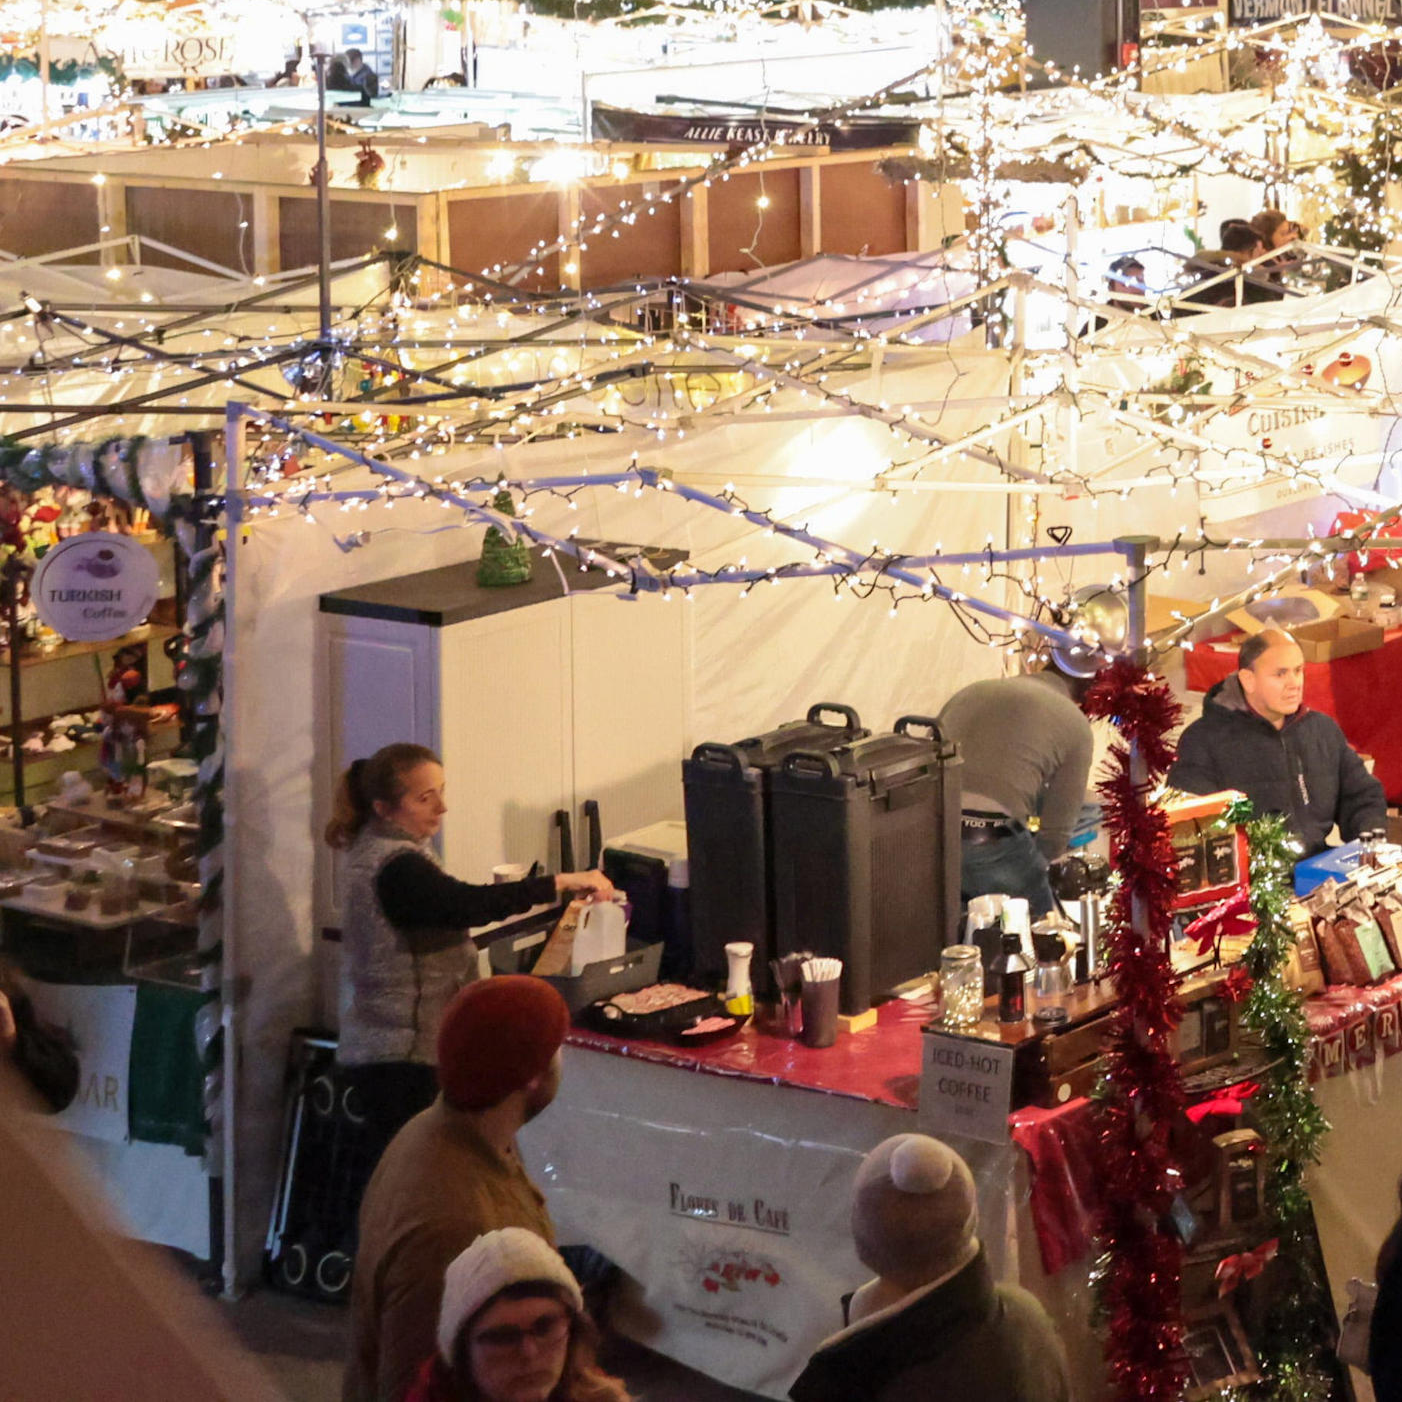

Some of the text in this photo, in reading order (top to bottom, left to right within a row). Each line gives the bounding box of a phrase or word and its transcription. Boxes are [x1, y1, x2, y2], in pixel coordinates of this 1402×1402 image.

[684, 126, 725, 140] ALLIE
[49, 589, 122, 603] TURKISH
[938, 1077, 991, 1103] COFFEE
